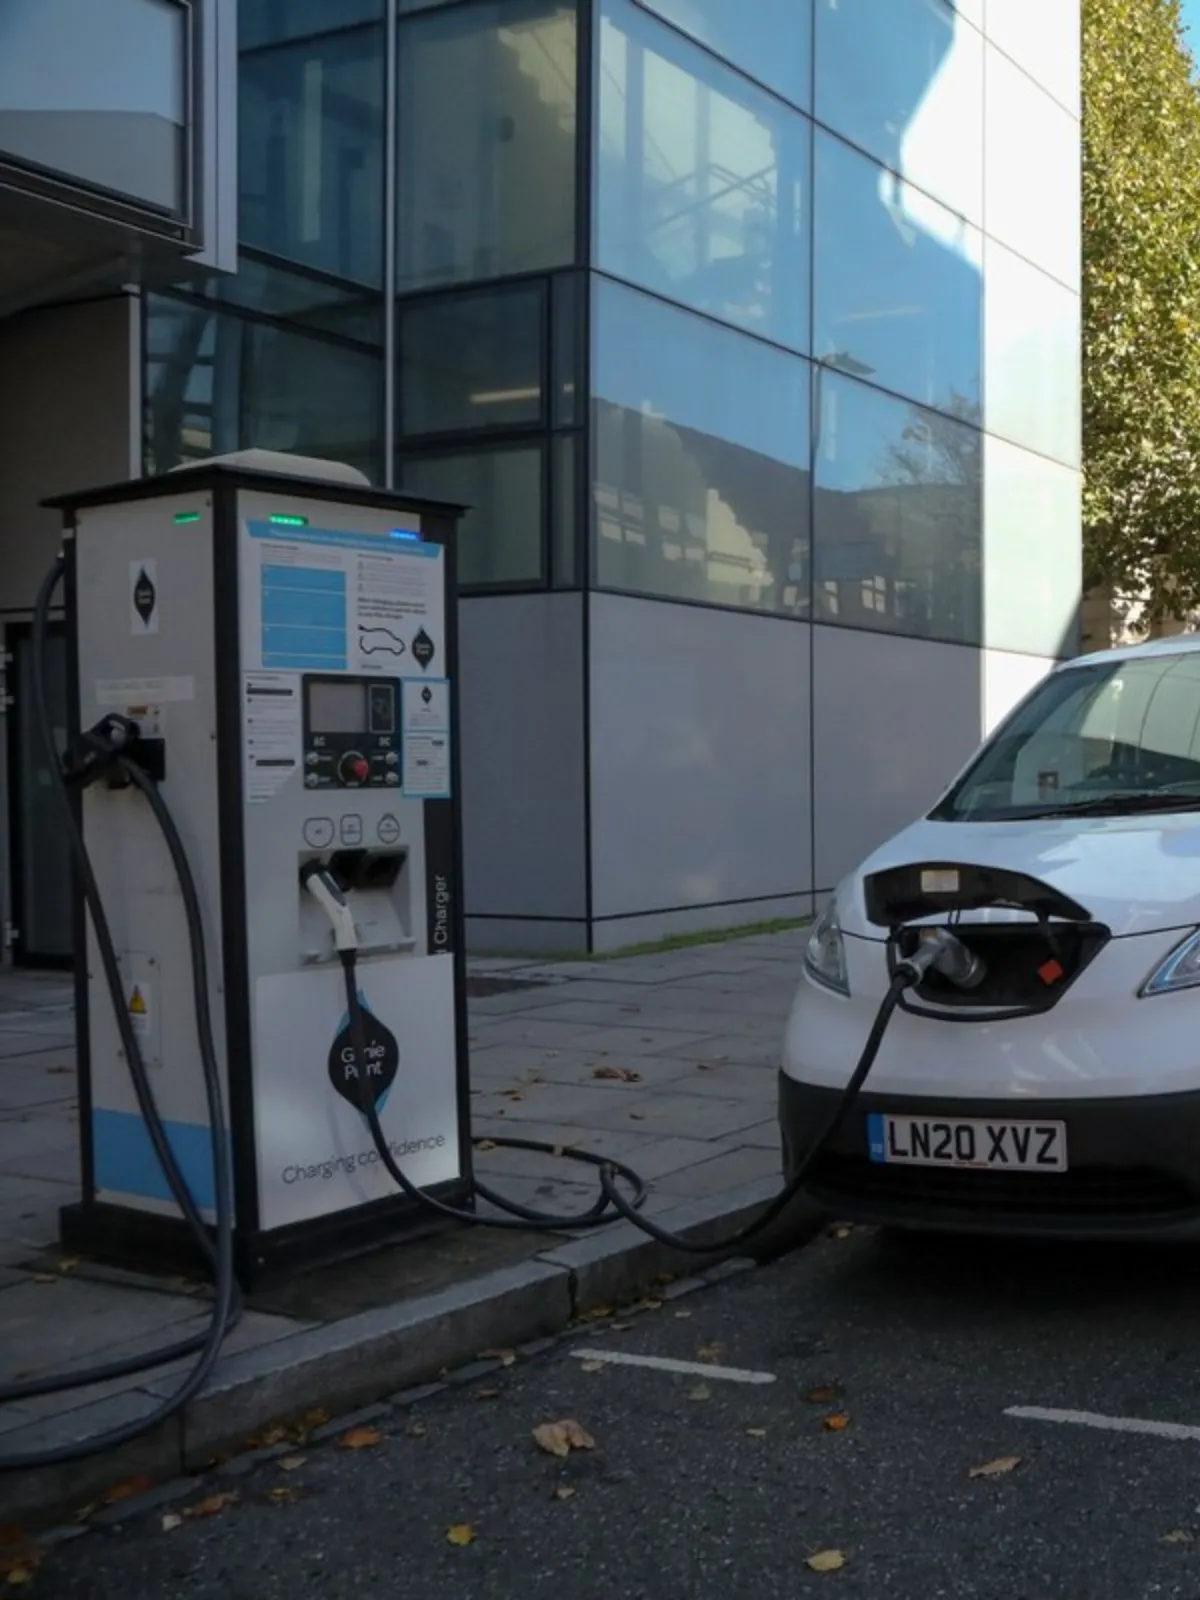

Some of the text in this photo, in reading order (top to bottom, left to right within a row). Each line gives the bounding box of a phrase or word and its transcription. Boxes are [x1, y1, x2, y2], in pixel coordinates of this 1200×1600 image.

[433, 874, 450, 945] Charger
[341, 1040, 386, 1063] Gnie
[344, 1061, 384, 1081] Pnt
[282, 1135, 445, 1184] Charging cofidence
[889, 1121, 1058, 1165] LN20 XVZ
